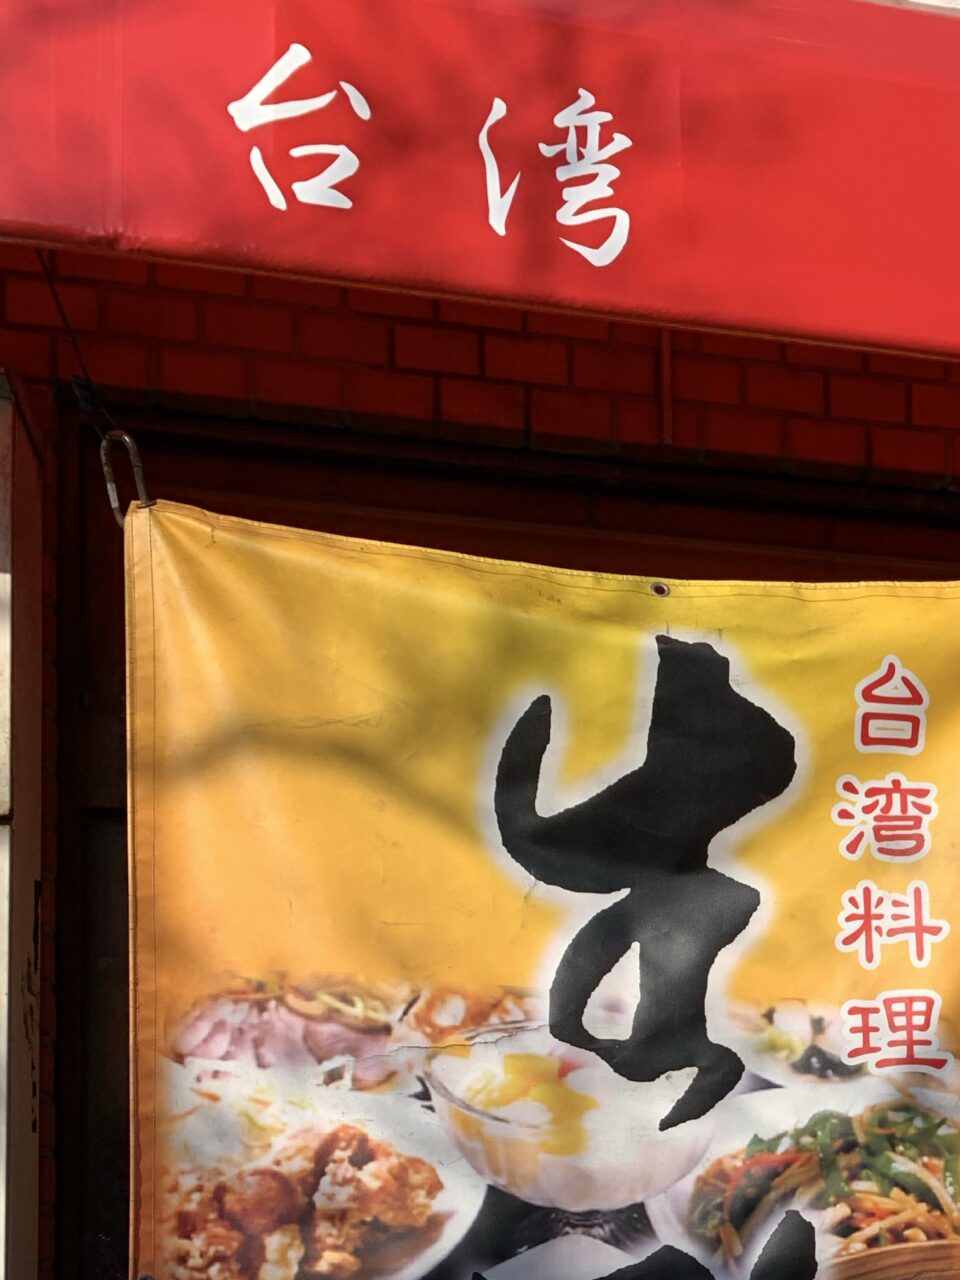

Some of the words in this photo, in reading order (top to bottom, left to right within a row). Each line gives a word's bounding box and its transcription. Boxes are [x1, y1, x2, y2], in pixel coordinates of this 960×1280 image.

[227, 43, 633, 267] 台湾
[836, 660, 950, 1072] 台湾料理
